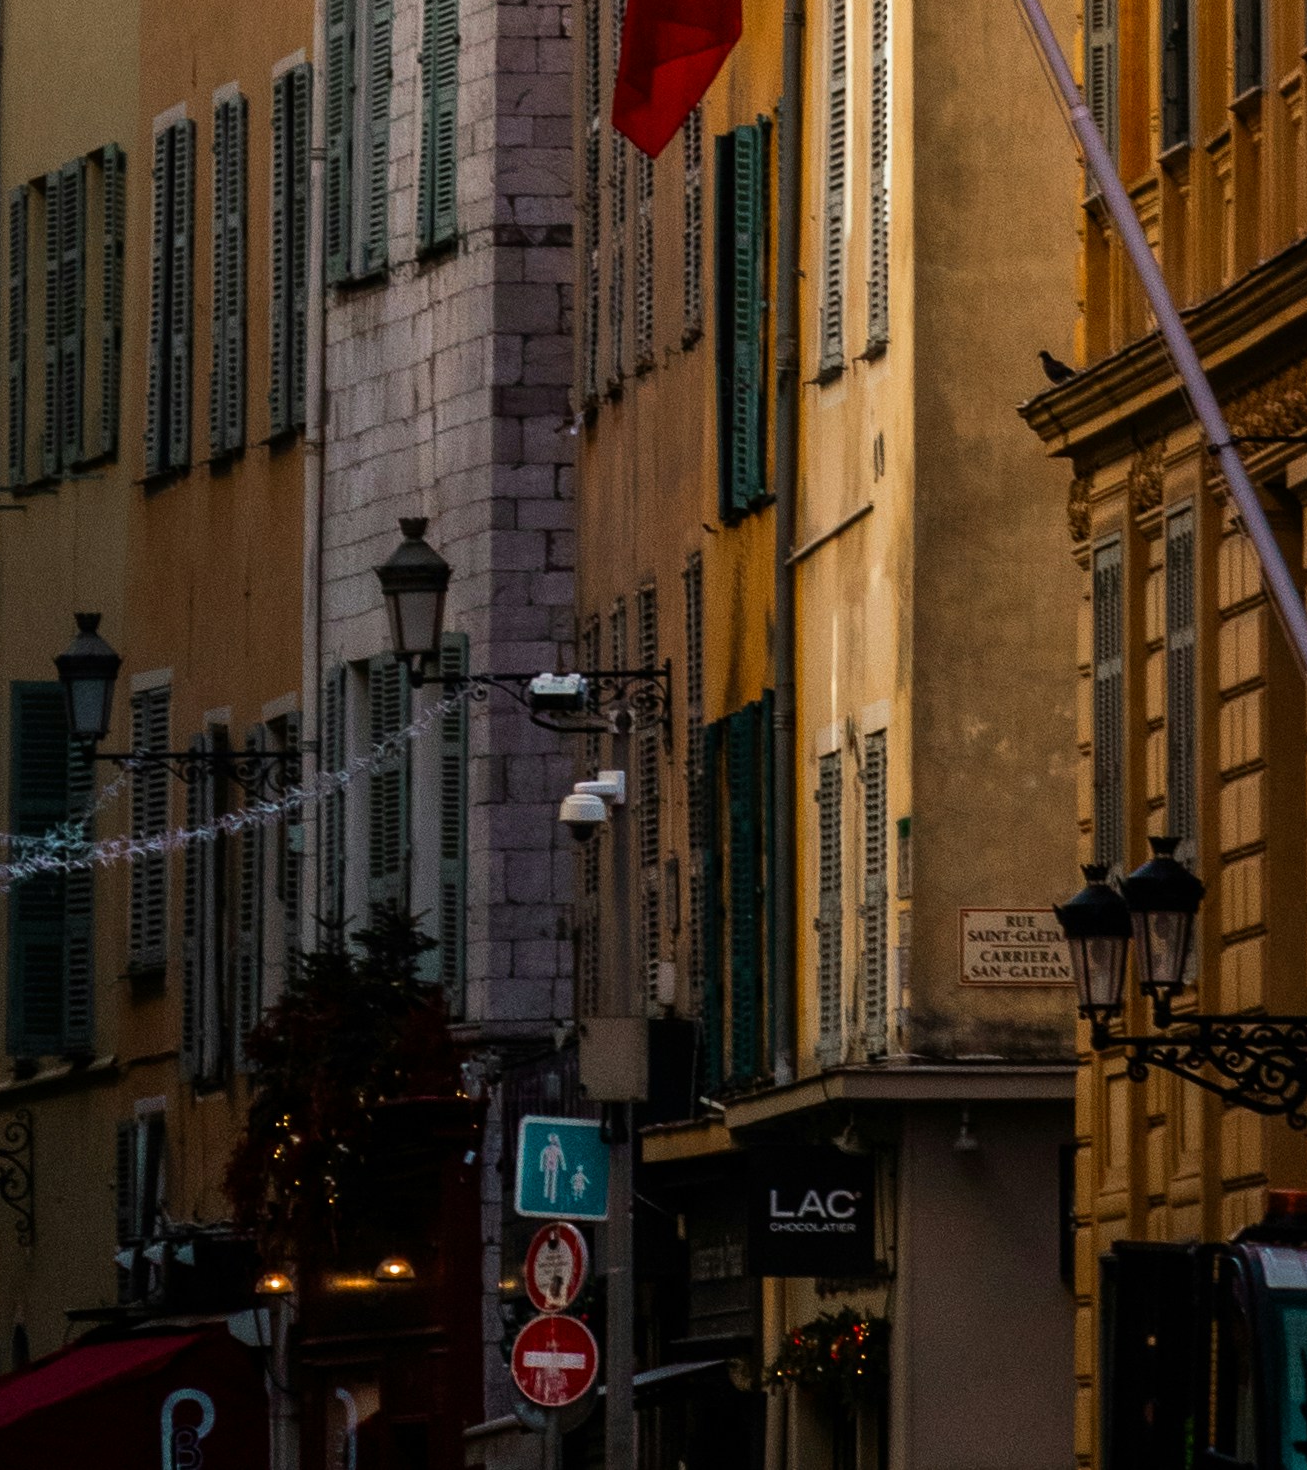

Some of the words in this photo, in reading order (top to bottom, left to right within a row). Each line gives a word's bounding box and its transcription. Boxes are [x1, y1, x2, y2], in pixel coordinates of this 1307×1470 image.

[1006, 916, 1035, 927] RUE
[980, 951, 1061, 962] CARRIERA
[971, 966, 1069, 978] SAN-GAETAN
[769, 1189, 856, 1219] LAC
[769, 1222, 856, 1233] CHOCOLATIER
